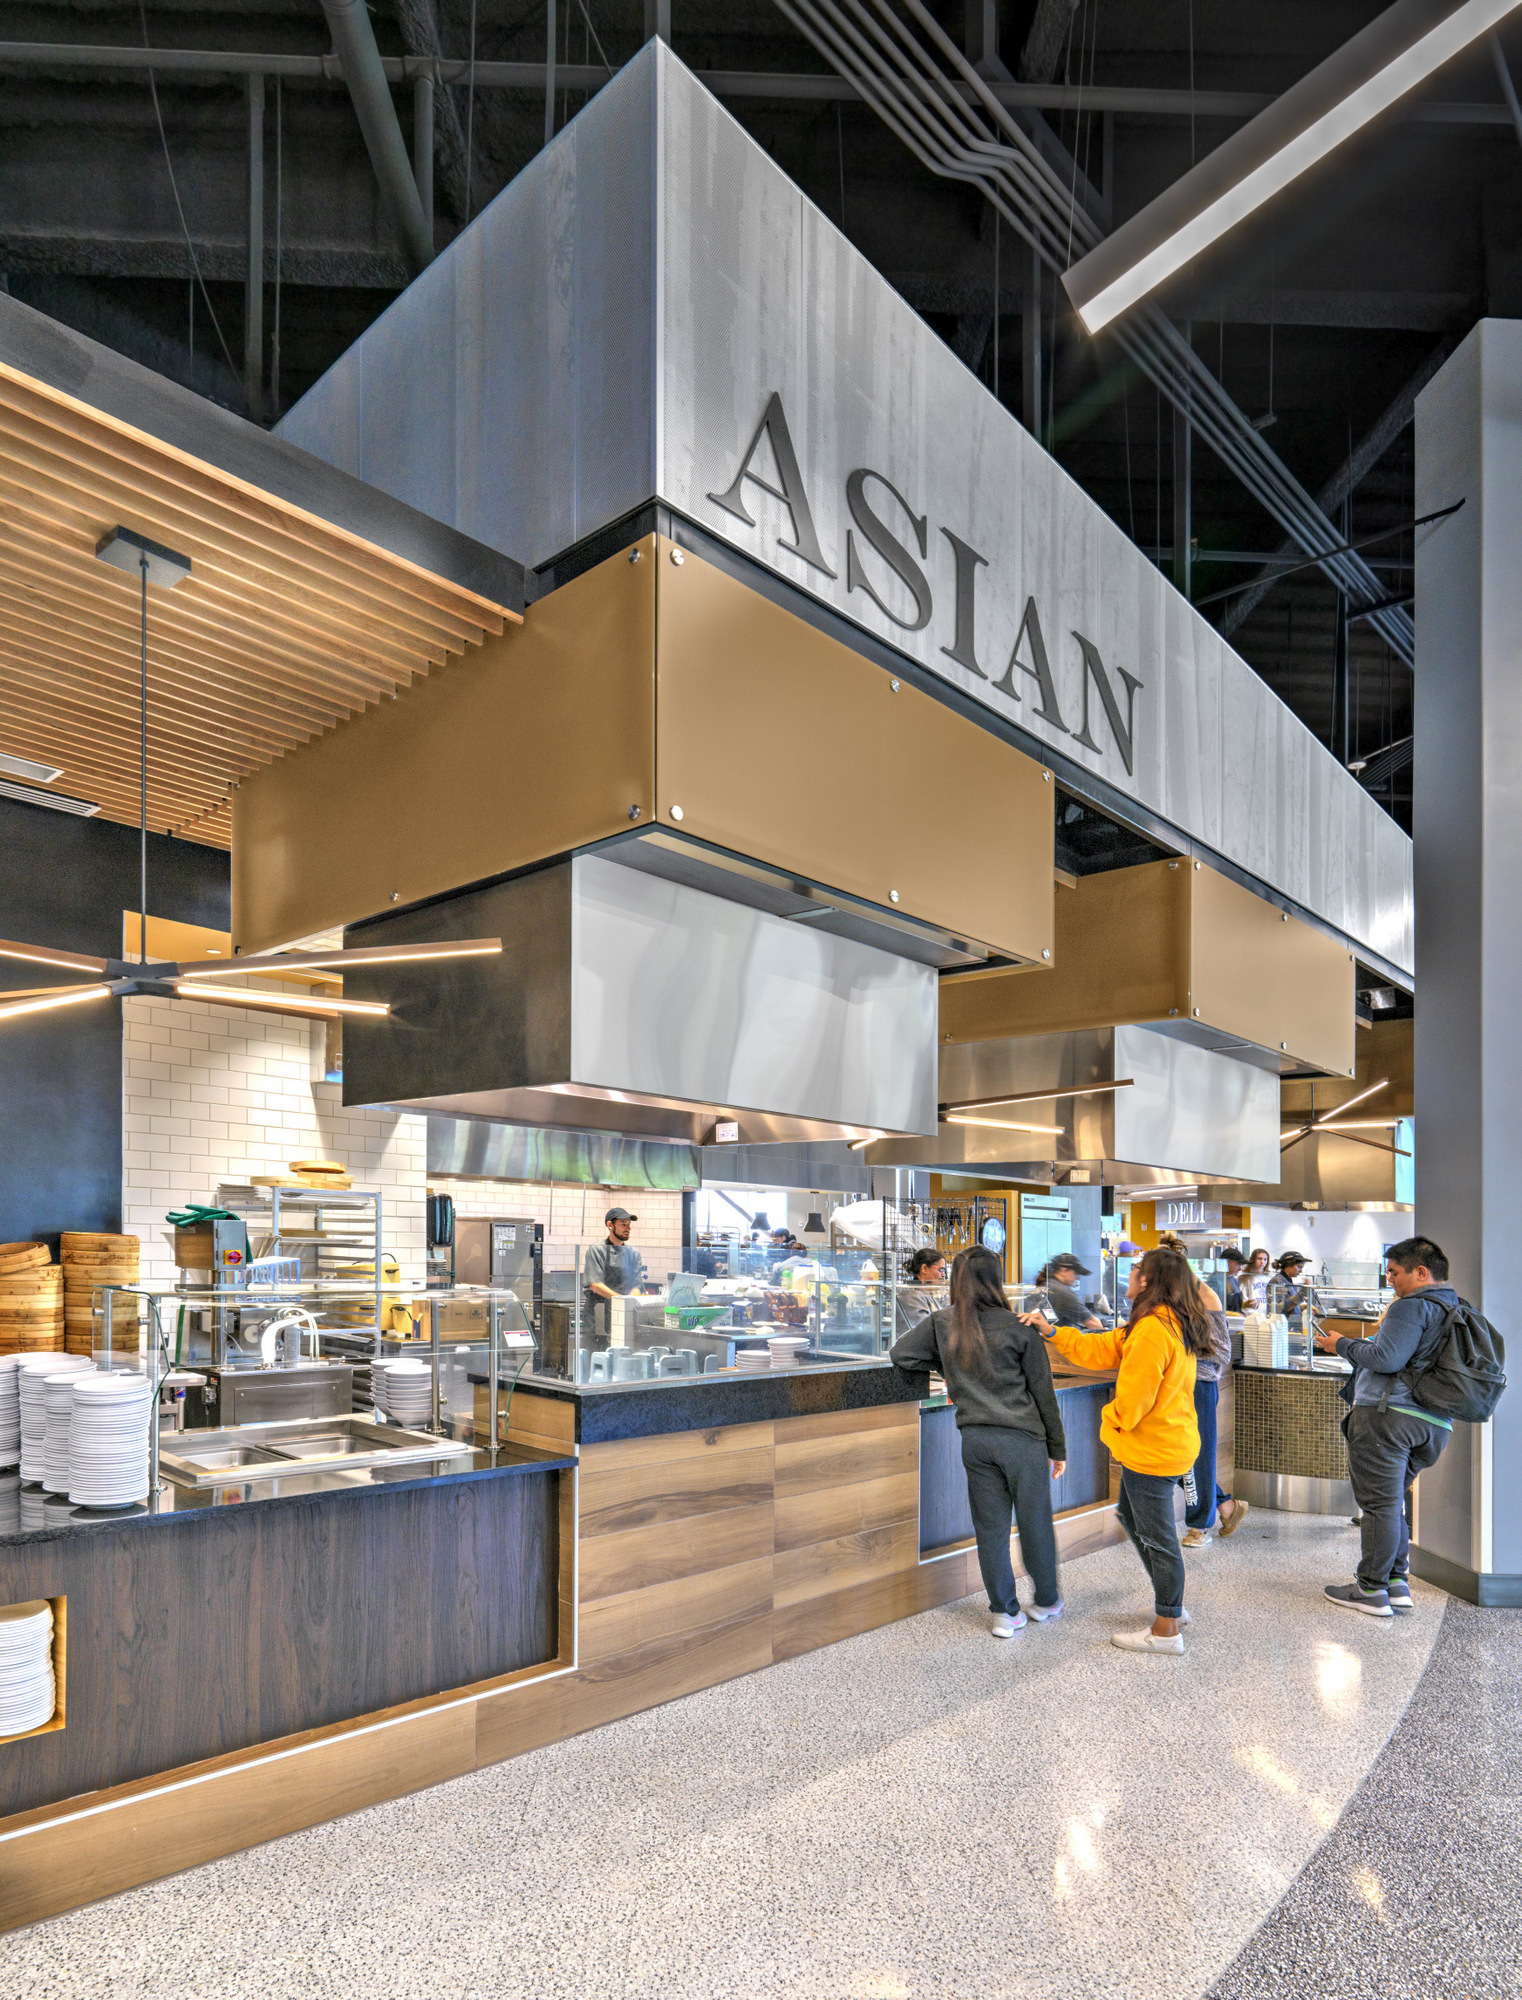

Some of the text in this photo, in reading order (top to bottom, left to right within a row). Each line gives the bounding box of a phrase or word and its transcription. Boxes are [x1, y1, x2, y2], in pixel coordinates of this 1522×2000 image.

[707, 391, 1144, 777] ASIAN
[1167, 1201, 1206, 1225] DELI
[1363, 1300, 1389, 1312] Cre
